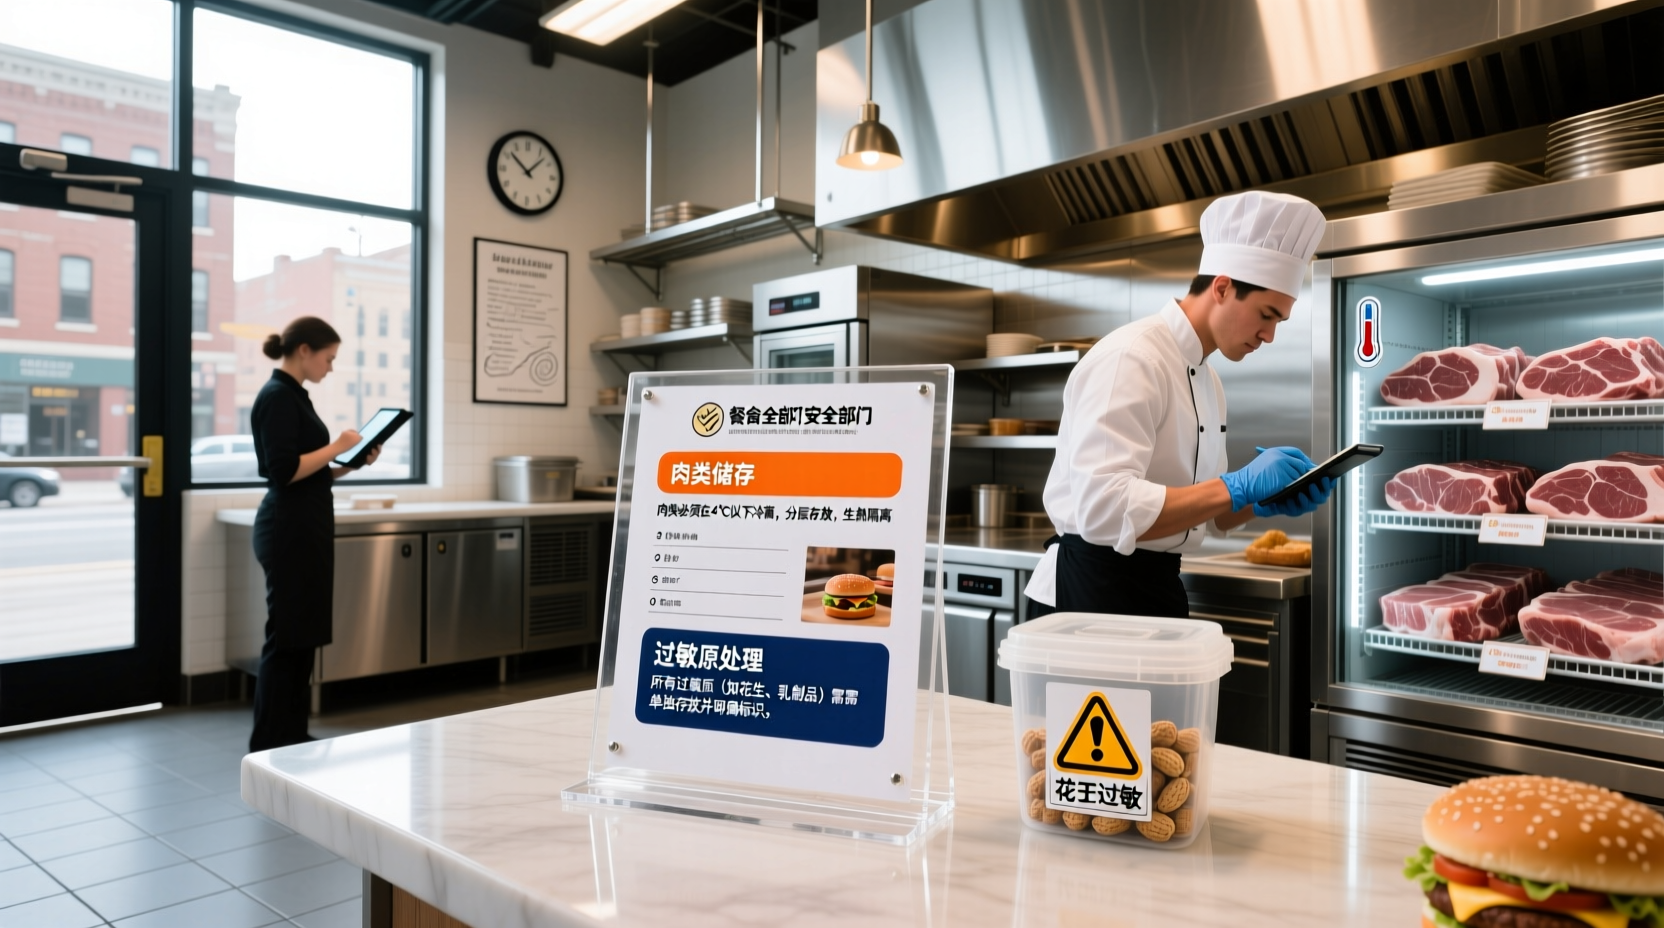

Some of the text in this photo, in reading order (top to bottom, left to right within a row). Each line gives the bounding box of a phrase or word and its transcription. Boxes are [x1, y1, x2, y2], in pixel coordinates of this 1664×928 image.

[670, 461, 755, 486] 肉类储存
[653, 640, 764, 673] 过敏原处理
